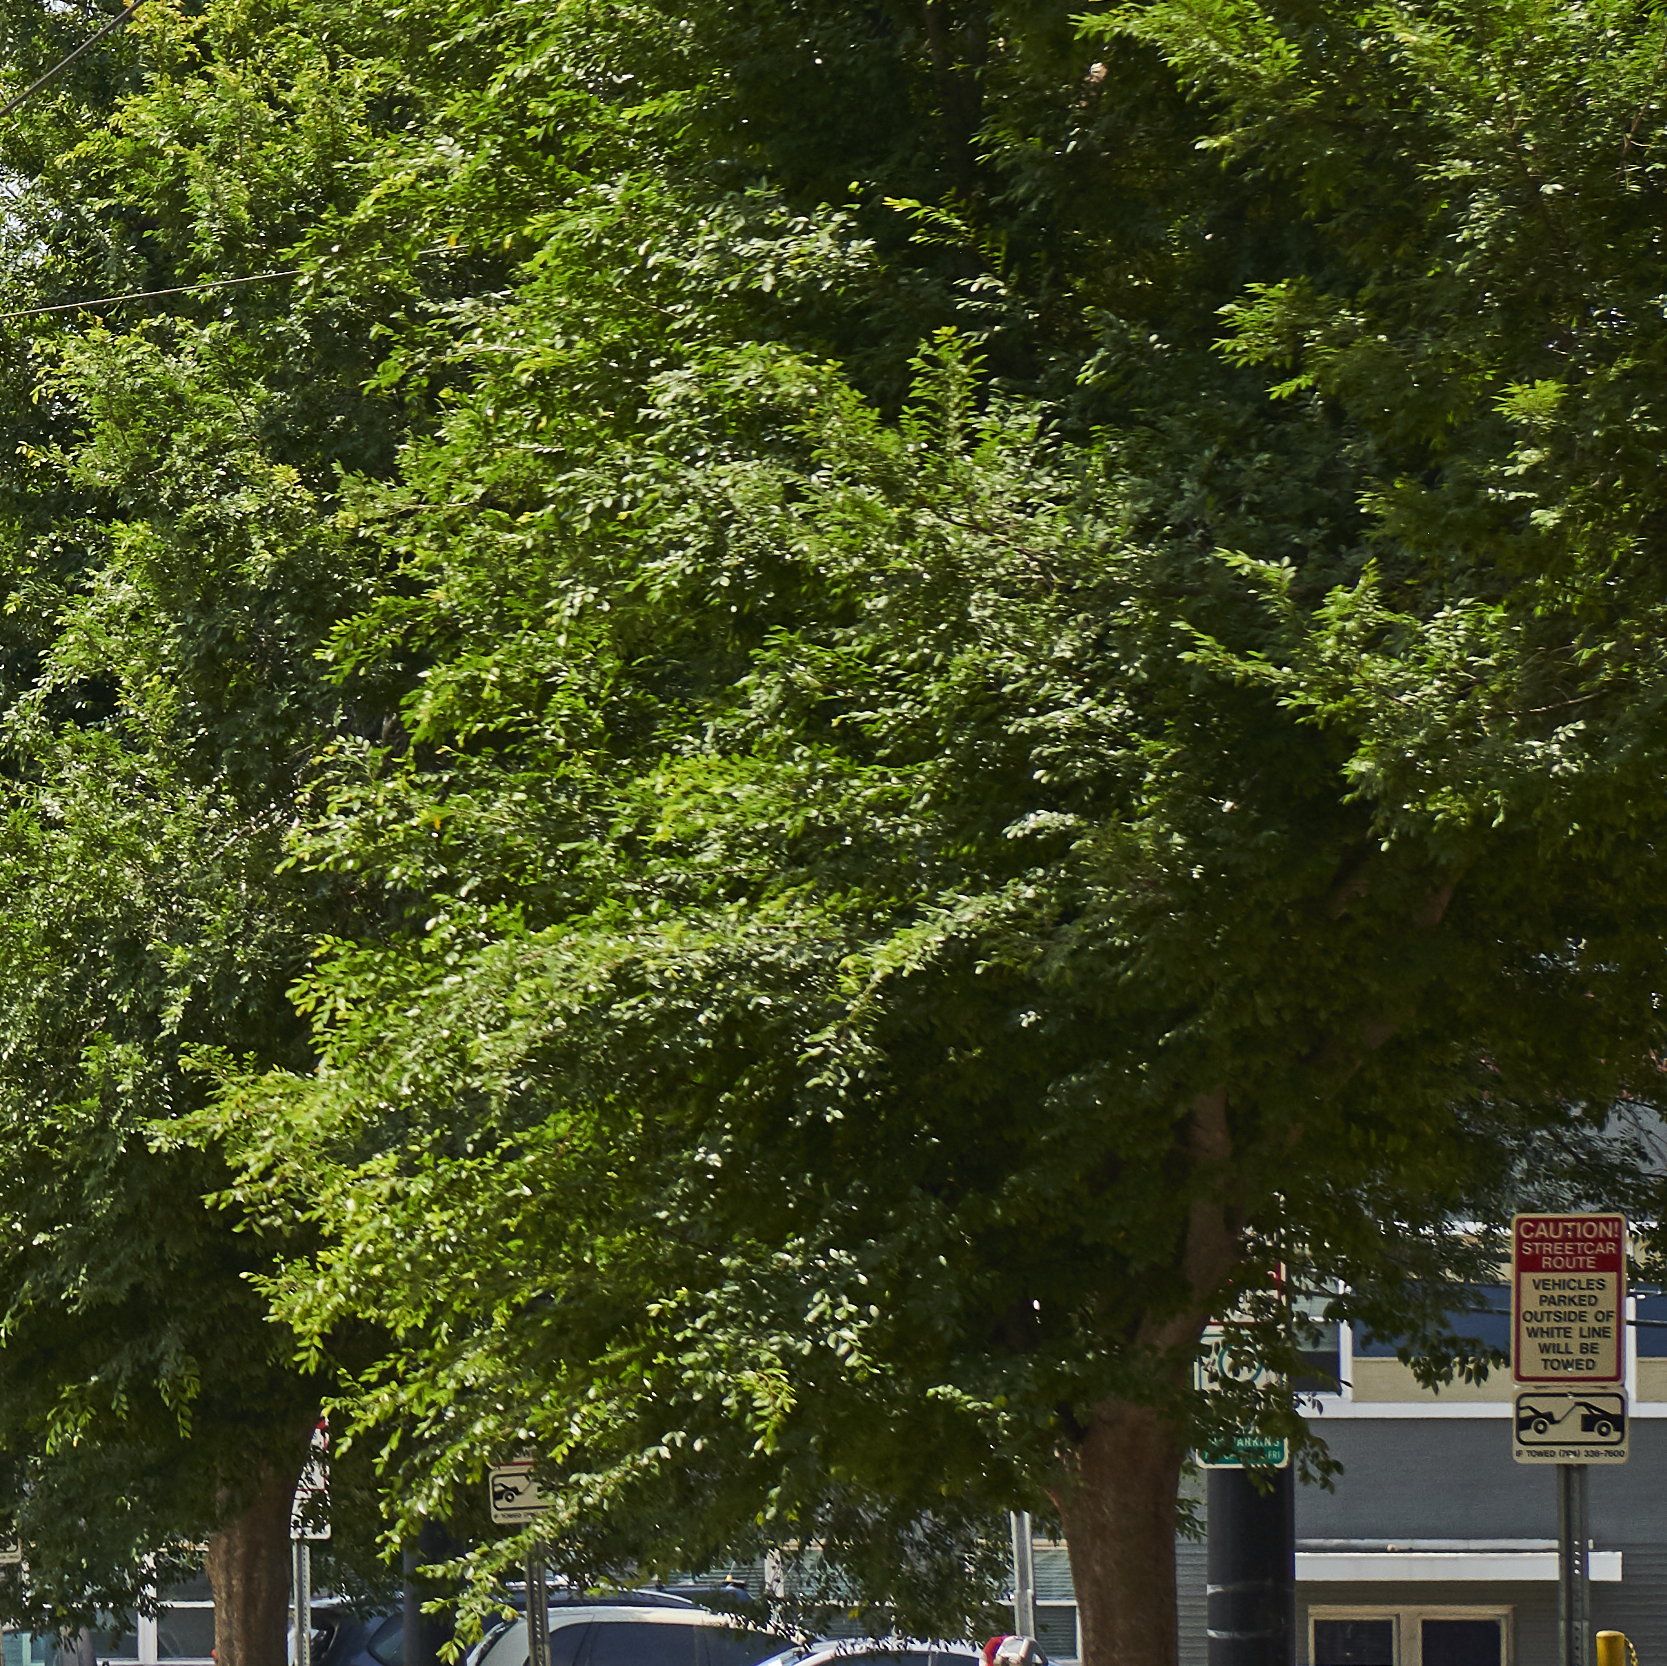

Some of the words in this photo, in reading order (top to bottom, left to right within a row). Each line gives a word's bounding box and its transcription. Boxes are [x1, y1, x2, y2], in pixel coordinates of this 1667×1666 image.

[1519, 1221, 1619, 1239] CAUTION!
[1521, 1242, 1616, 1254] STREETCAR
[1541, 1256, 1597, 1269] ROUTE
[1532, 1278, 1606, 1290] VEHICLES
[1538, 1294, 1598, 1306] PARKED
[1522, 1310, 1587, 1322] OUTSIDE
[1594, 1310, 1614, 1322] OF
[1526, 1326, 1573, 1338] WHITE
[1579, 1326, 1611, 1338] LINE
[1538, 1342, 1573, 1354] WILL
[1579, 1342, 1599, 1354] BE
[1541, 1358, 1596, 1370] TOWED
[1526, 1449, 1556, 1457] TOWED
